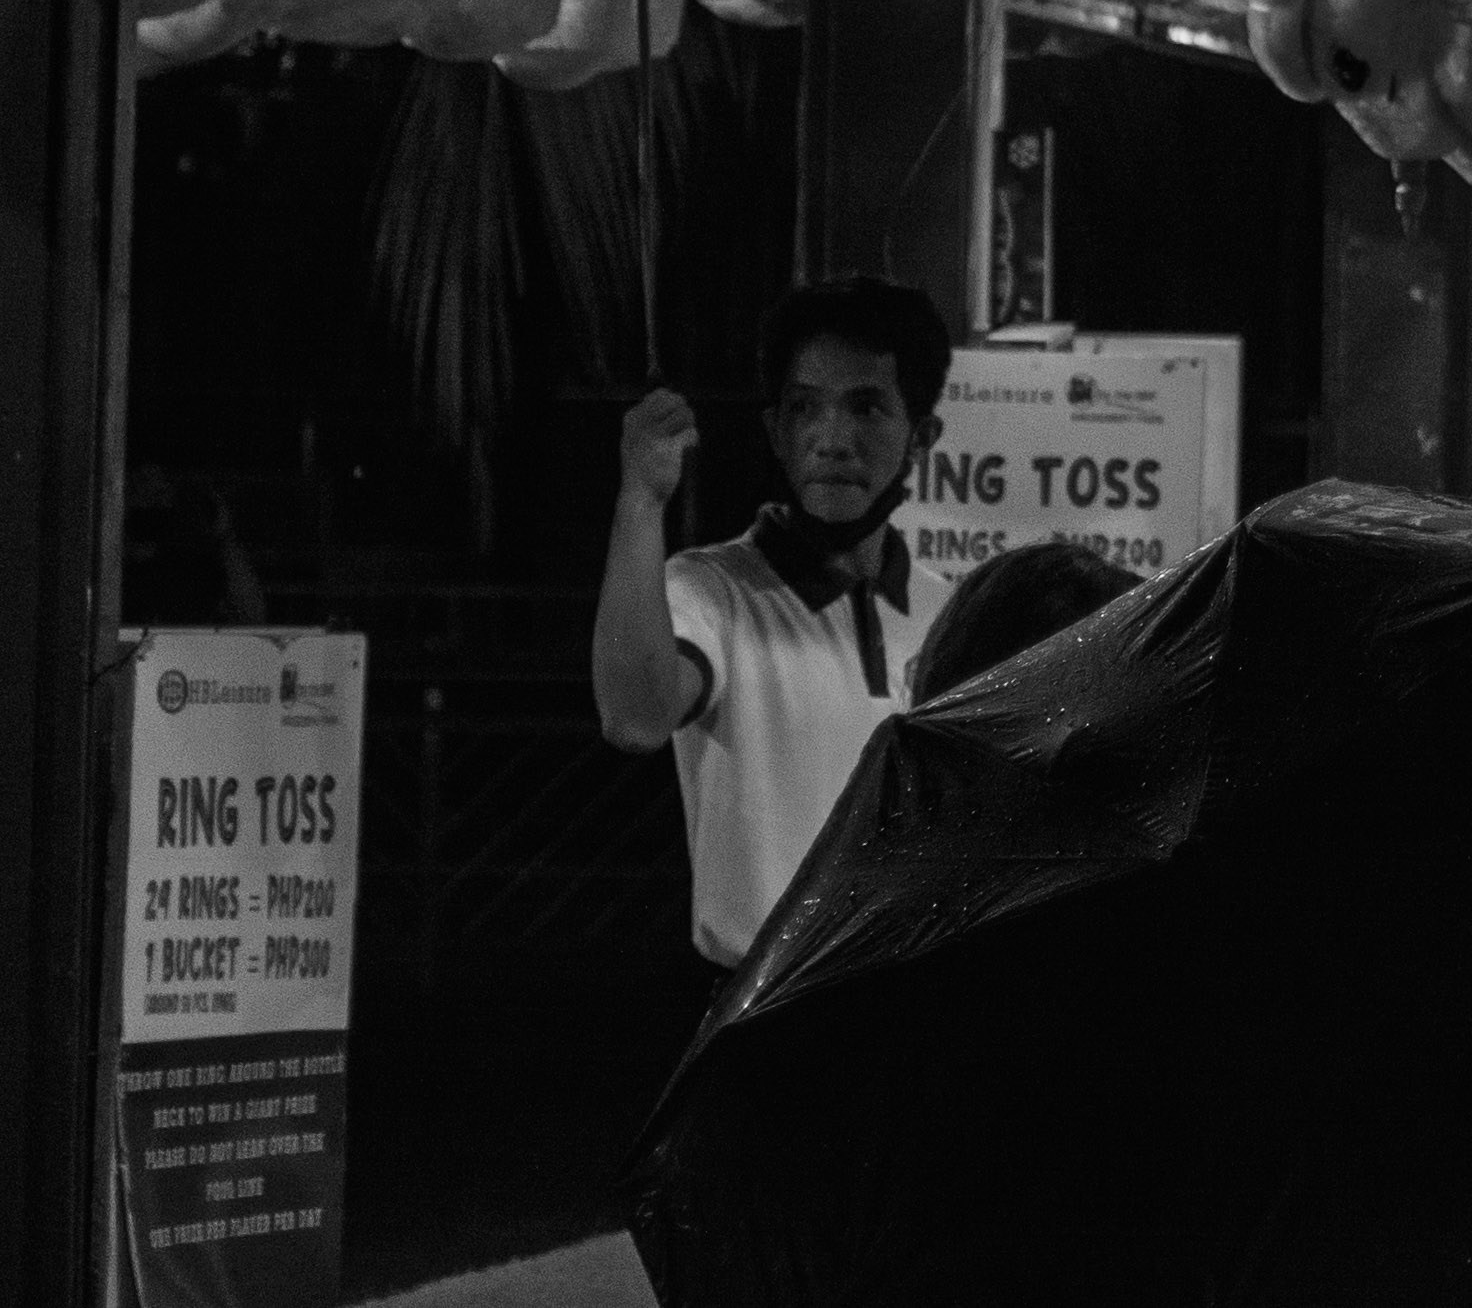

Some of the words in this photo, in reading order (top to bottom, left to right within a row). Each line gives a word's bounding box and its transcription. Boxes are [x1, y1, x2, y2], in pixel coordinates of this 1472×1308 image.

[906, 452, 1005, 505] ING
[1031, 456, 1161, 510] TOSS
[917, 529, 1006, 561] RINGS
[157, 775, 239, 849] RING
[255, 773, 337, 846] TOSS
[178, 875, 240, 920] RINGS
[266, 874, 335, 920] PHP200
[145, 941, 155, 983] 1
[162, 936, 240, 983] BUCKET
